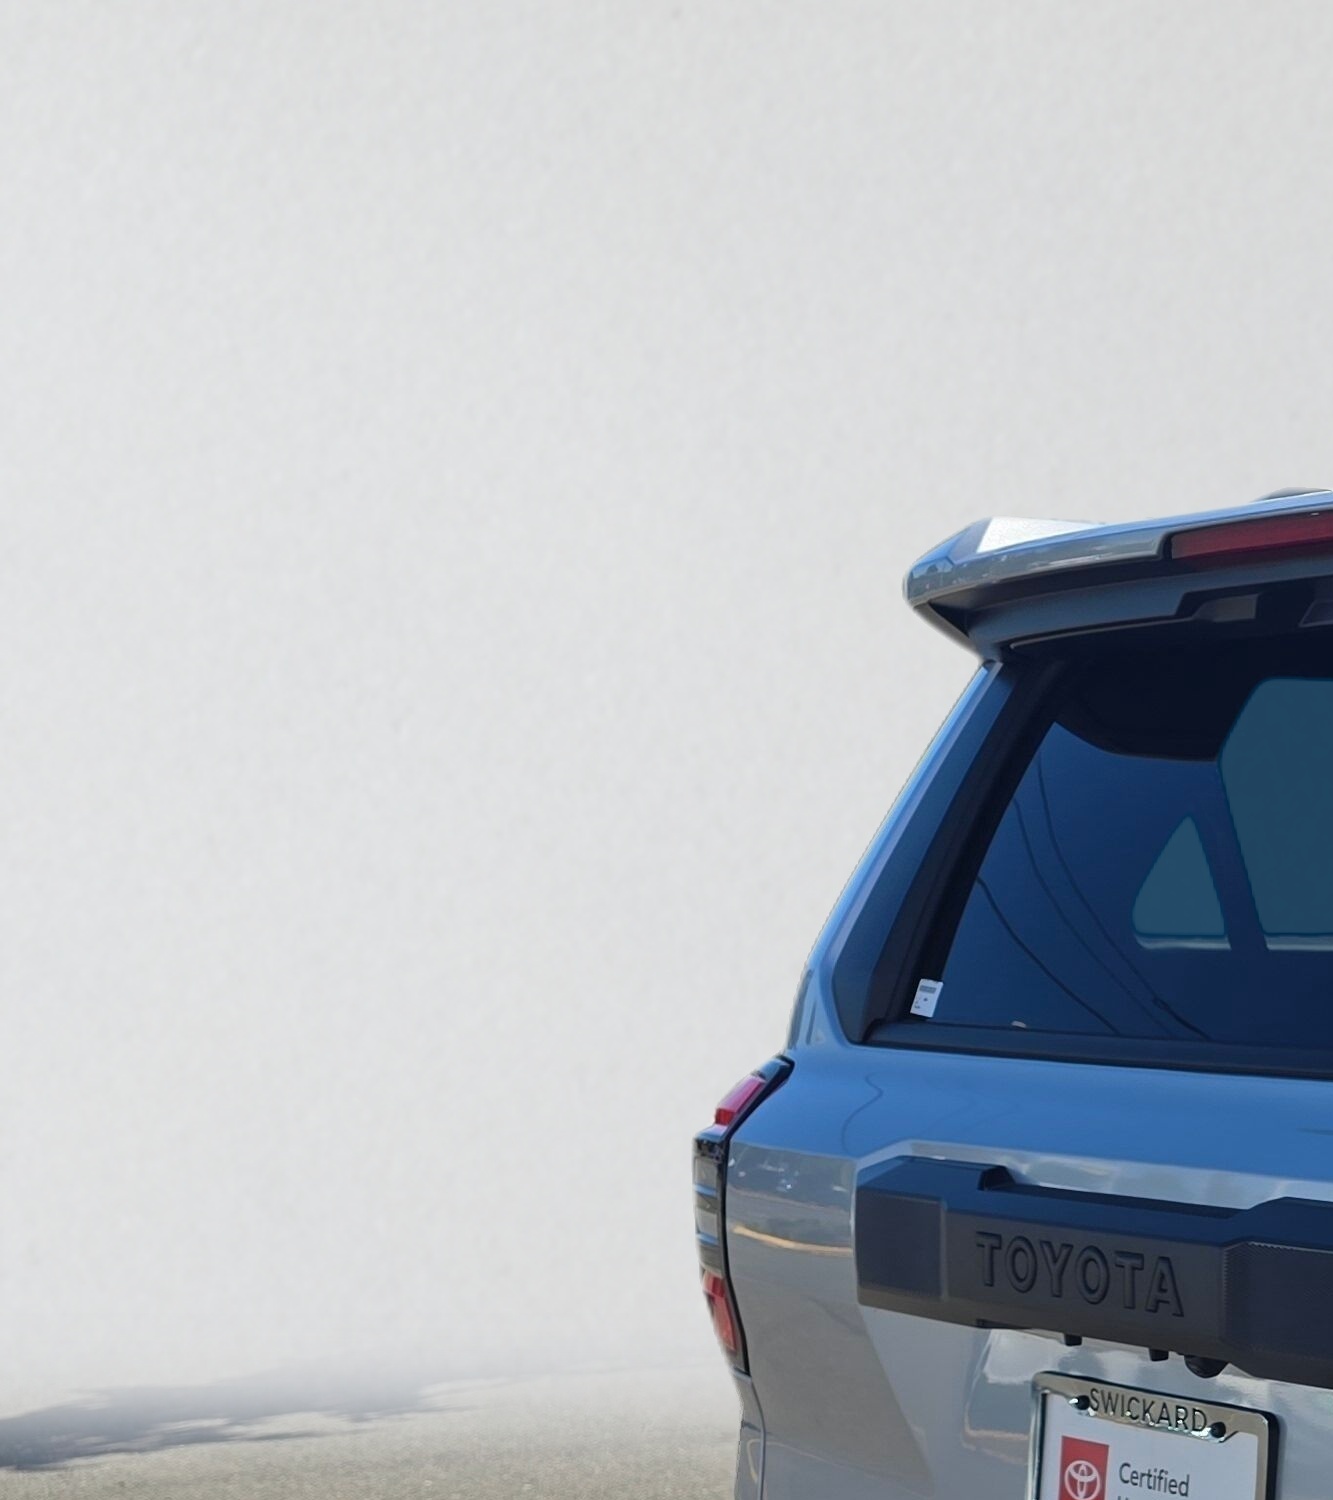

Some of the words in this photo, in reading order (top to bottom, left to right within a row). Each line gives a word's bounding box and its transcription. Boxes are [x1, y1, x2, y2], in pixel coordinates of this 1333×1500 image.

[976, 1231, 1184, 1317] TOYOTA
[1089, 1388, 1208, 1432] SWICKARD
[1119, 1462, 1190, 1497] Certified
